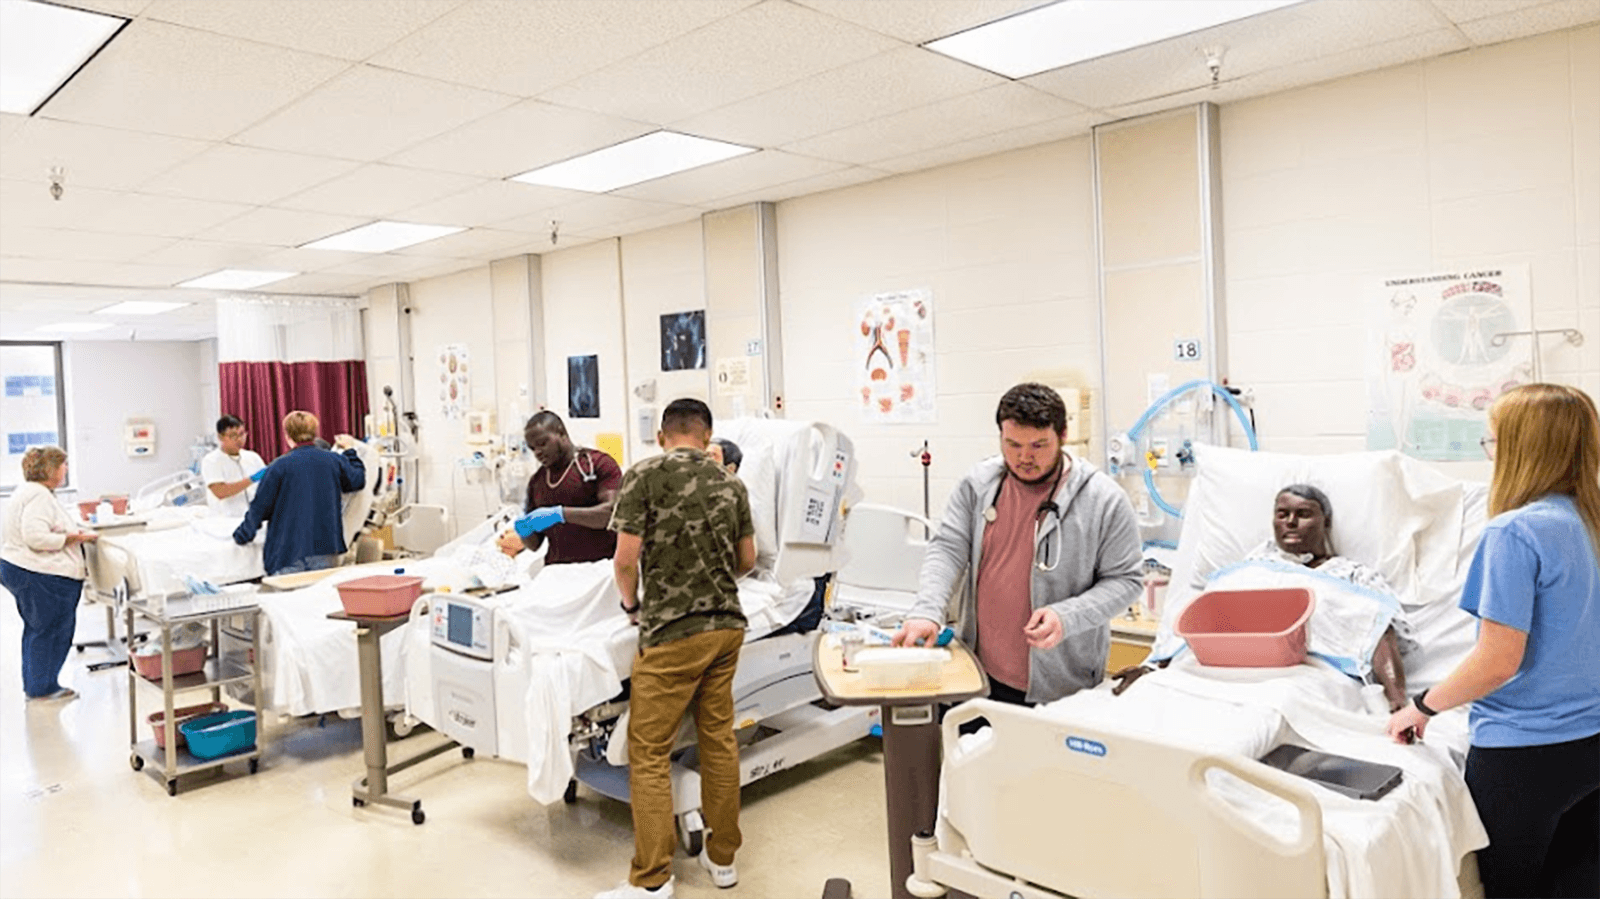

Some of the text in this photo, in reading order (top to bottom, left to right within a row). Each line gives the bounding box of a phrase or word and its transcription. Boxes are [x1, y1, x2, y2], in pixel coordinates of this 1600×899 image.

[1385, 270, 1503, 287] UNDERSTANDING CANCER
[1177, 342, 1197, 358] 18
